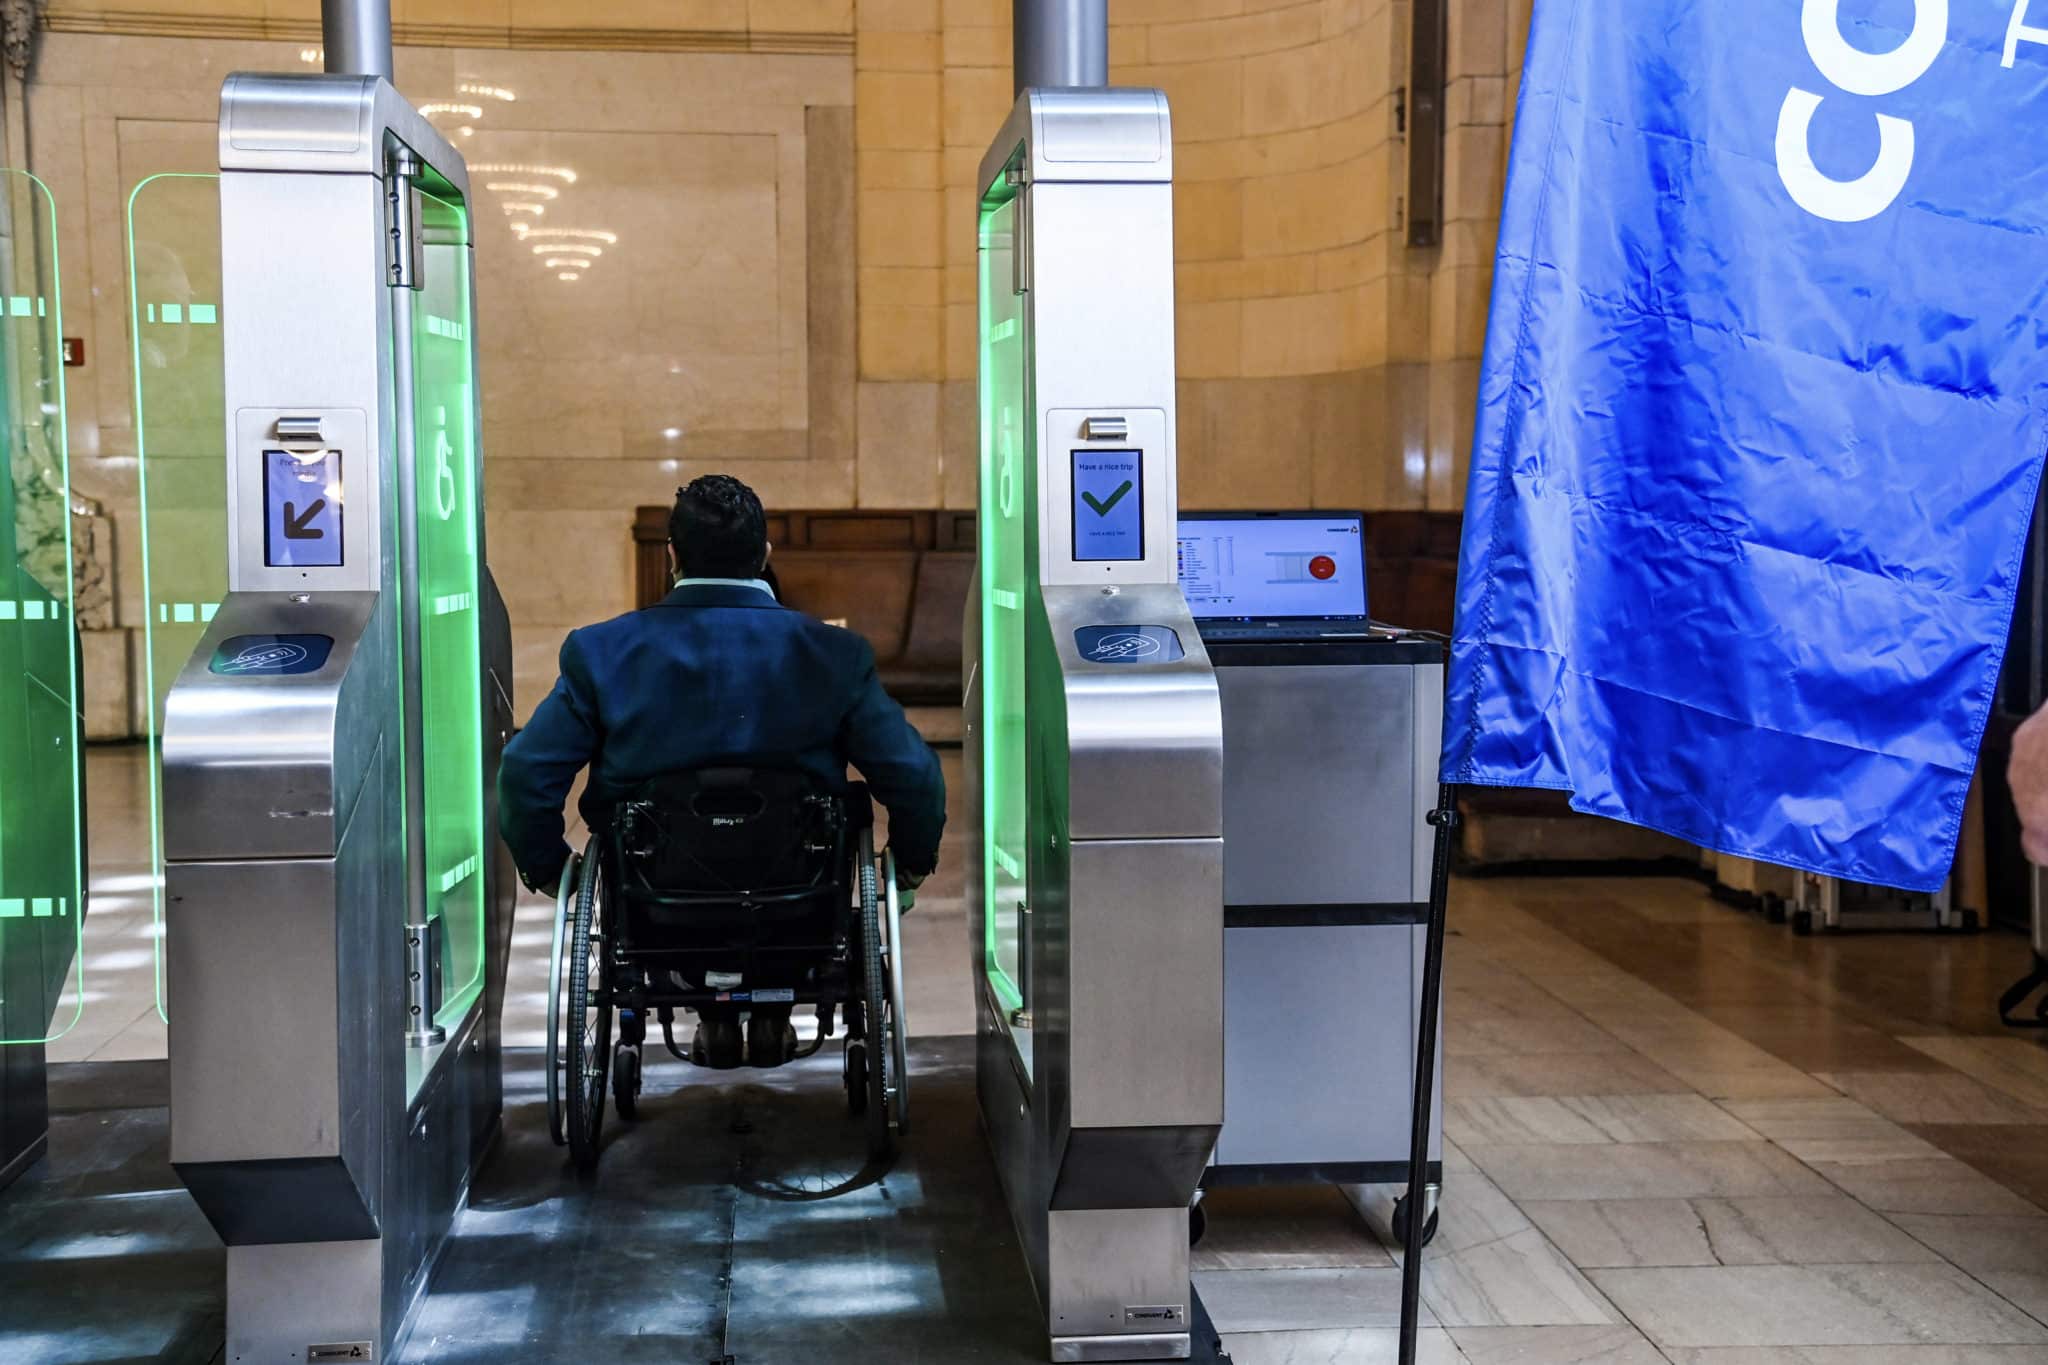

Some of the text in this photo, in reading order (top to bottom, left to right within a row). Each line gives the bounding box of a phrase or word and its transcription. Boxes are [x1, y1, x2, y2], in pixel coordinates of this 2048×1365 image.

[1079, 463, 1097, 471] Have
[1104, 463, 1119, 471] nice
[1120, 463, 1134, 472] trip
